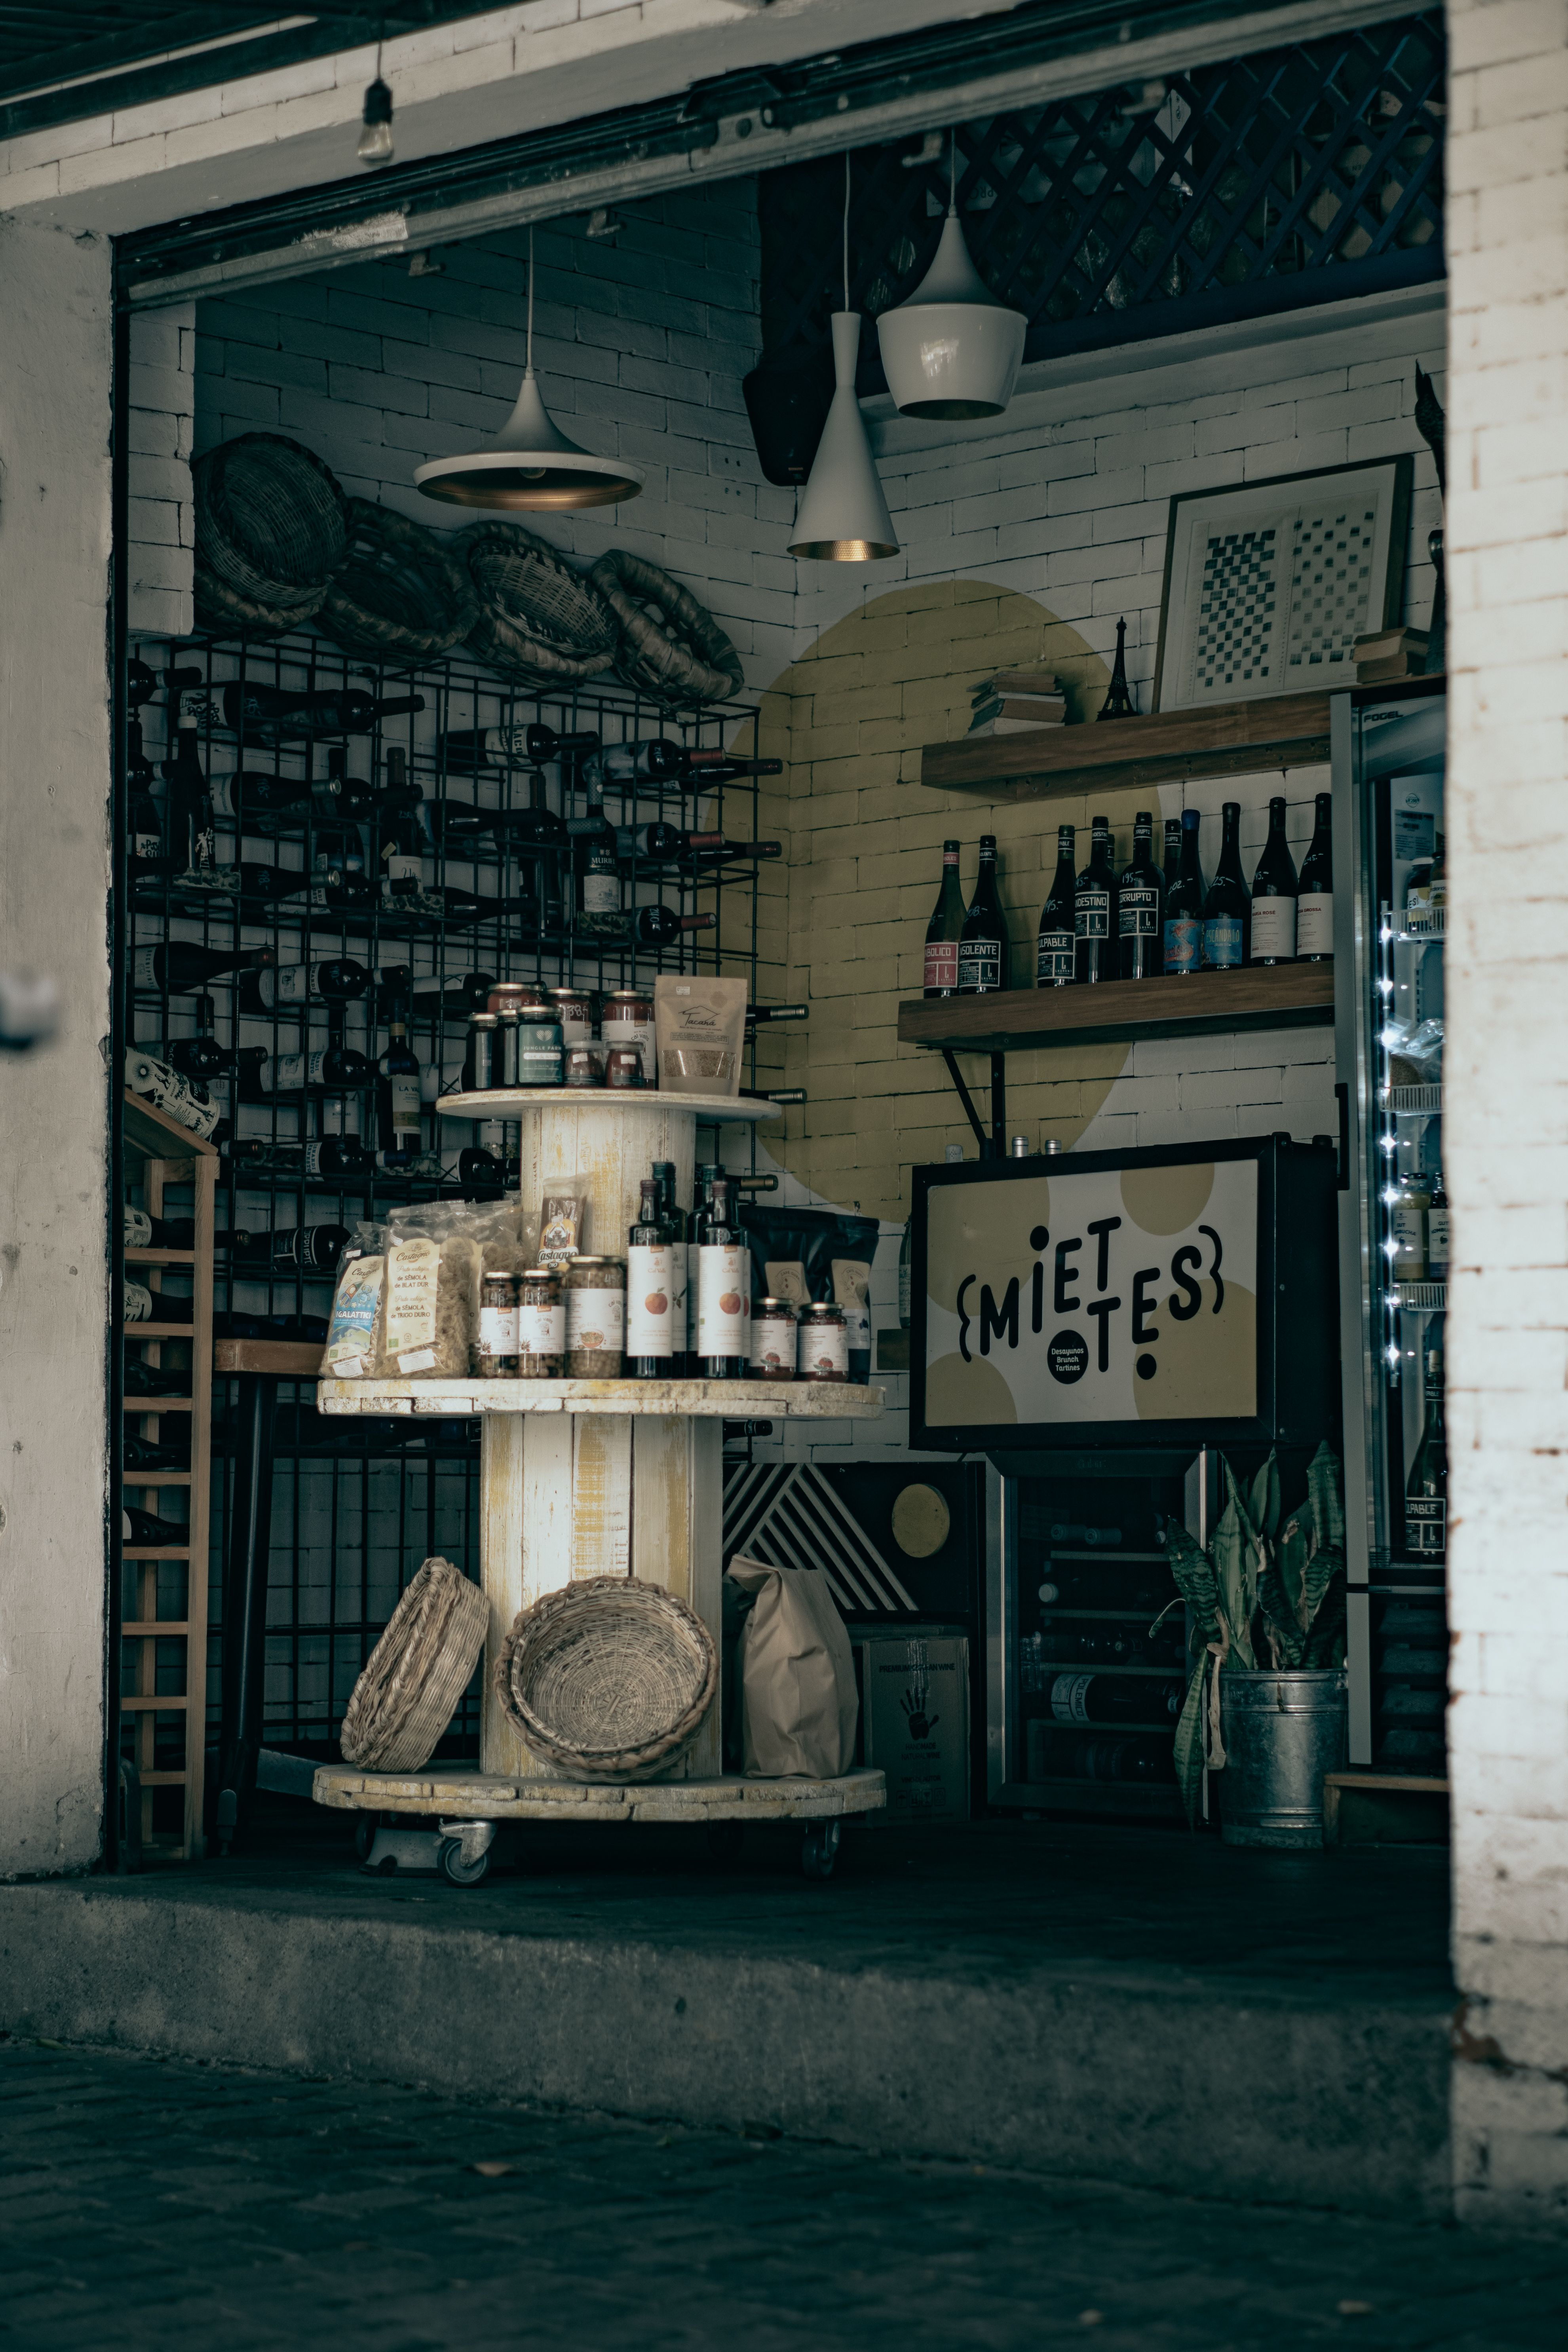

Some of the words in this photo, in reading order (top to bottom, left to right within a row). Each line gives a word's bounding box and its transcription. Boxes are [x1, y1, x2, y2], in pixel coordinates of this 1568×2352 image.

[1364, 711, 1403, 722] FOGEL
[338, 1311, 372, 1320] GALATTICI
[905, 1742, 936, 1751] HANDMADE
[901, 1752, 927, 1761] NATURAL
